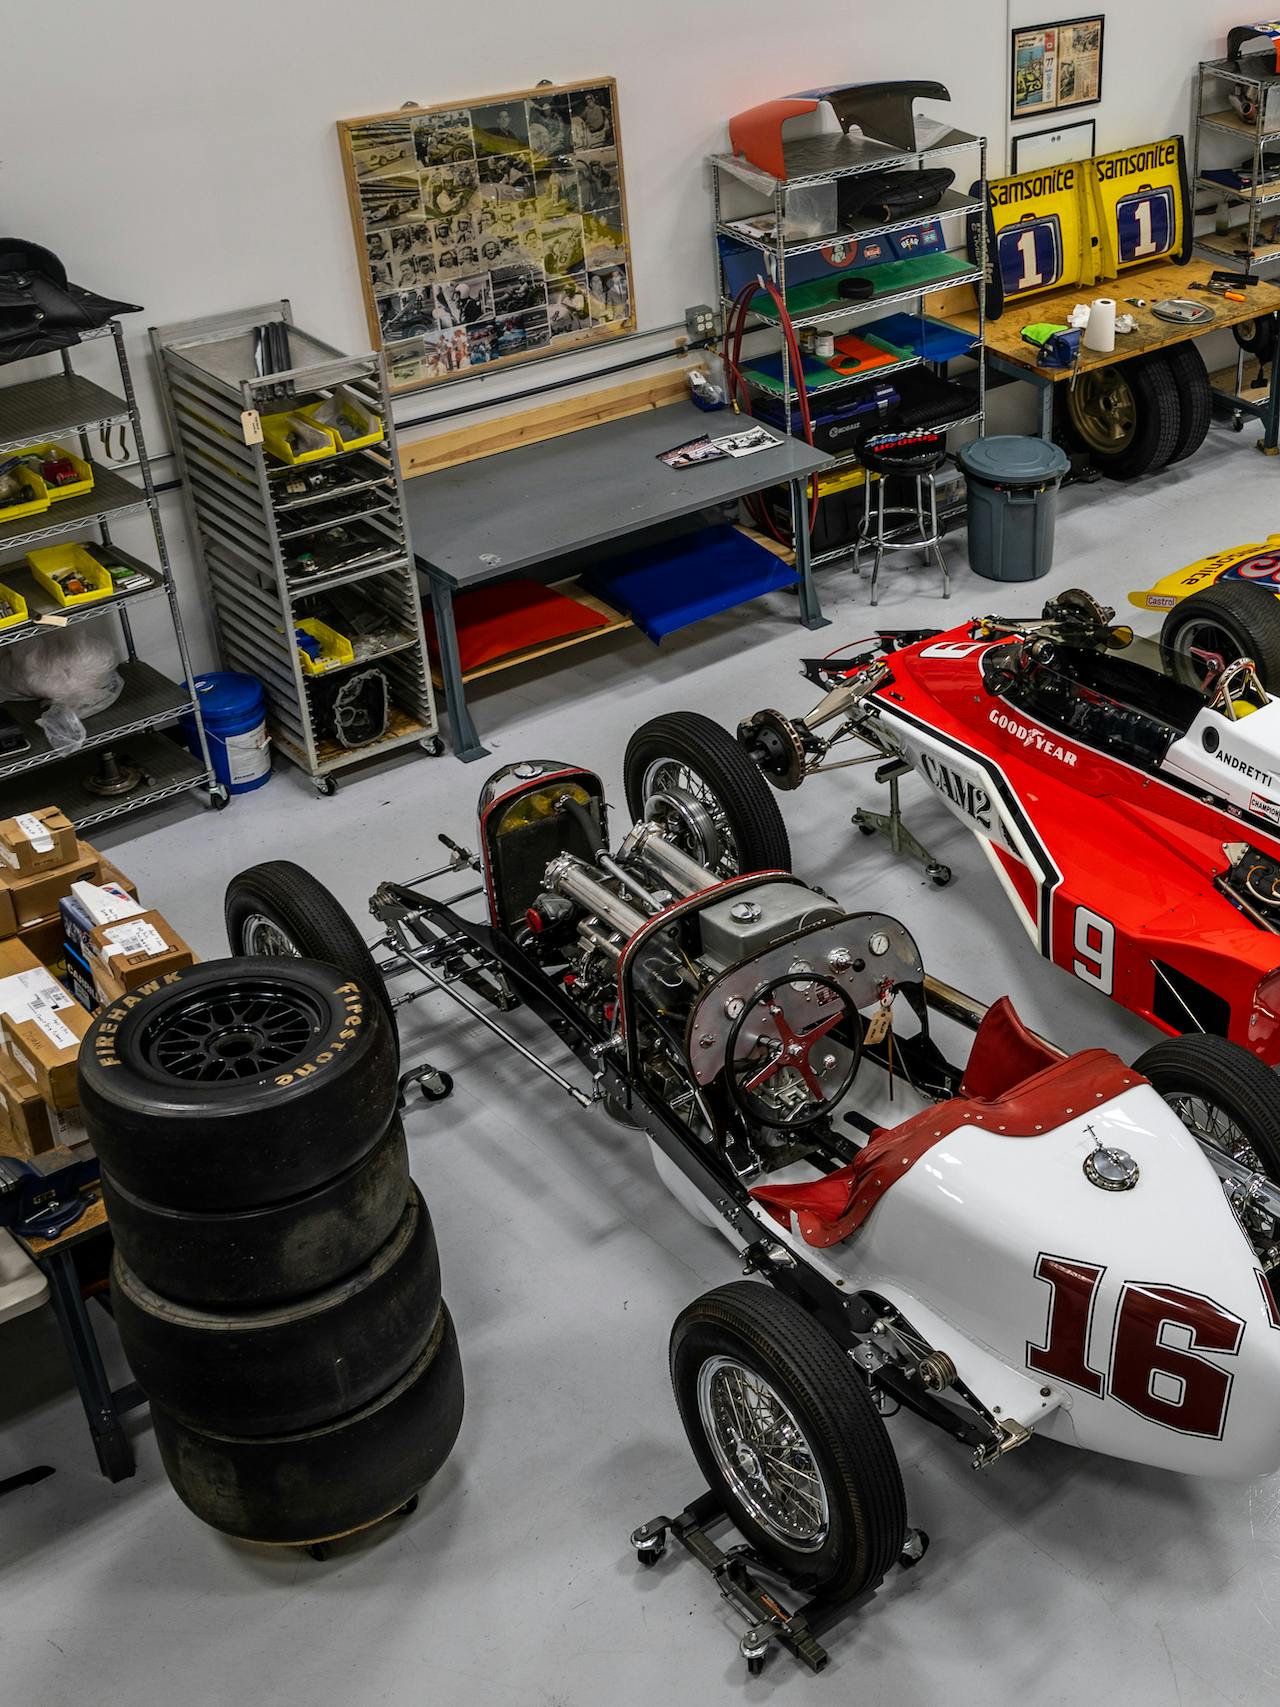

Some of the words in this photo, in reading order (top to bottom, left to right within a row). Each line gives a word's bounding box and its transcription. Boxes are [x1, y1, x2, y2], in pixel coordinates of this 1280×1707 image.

[1134, 200, 1157, 257] 1
[1016, 230, 1043, 290] 1
[1147, 596, 1175, 607] Castrol
[989, 708, 1078, 767] GOODYEAR
[921, 753, 992, 831] CAM2
[1216, 750, 1272, 787] ANDRETTI
[1251, 797, 1280, 818] CHAMPION
[1073, 904, 1115, 996] 9
[95, 970, 184, 1068] FIREHAWK
[274, 981, 361, 1087] Firestone
[1026, 1251, 1247, 1442] 16
